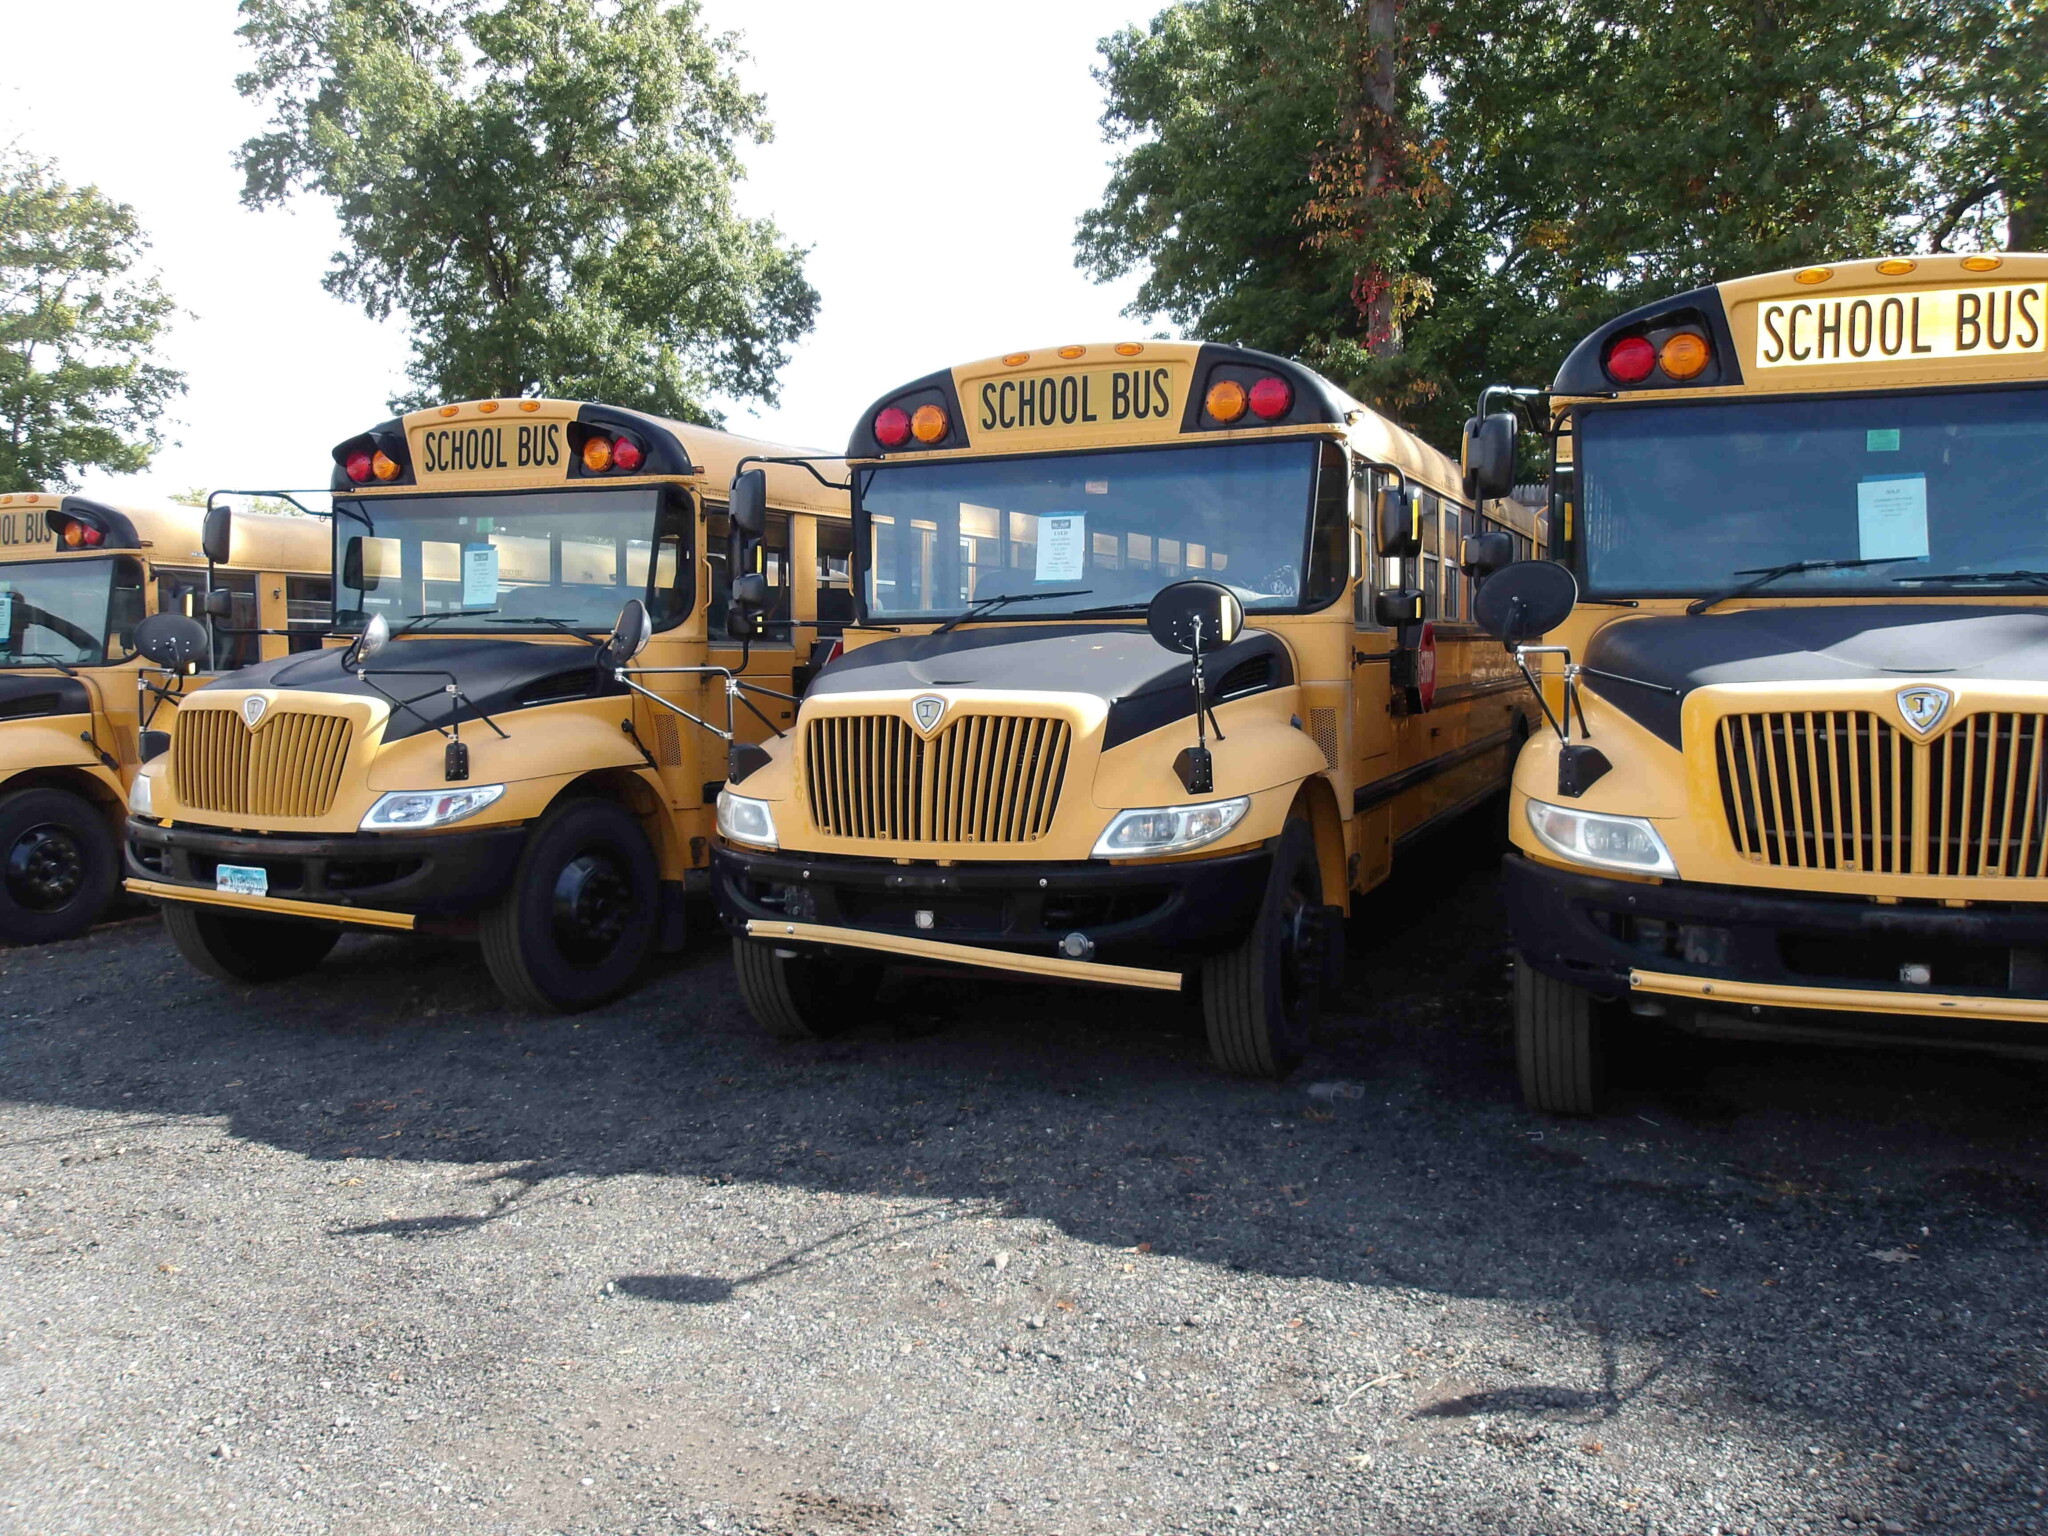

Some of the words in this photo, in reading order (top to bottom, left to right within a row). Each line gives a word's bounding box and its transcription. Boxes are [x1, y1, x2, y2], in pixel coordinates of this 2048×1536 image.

[1763, 297, 1932, 363] SCHOOL
[1956, 288, 2040, 351] BUS
[982, 375, 1098, 430] SCHOOL
[1112, 368, 1170, 420] BUS
[425, 428, 508, 472] SCHOOL
[518, 424, 559, 467] BUS
[1420, 651, 1434, 684] STOP
